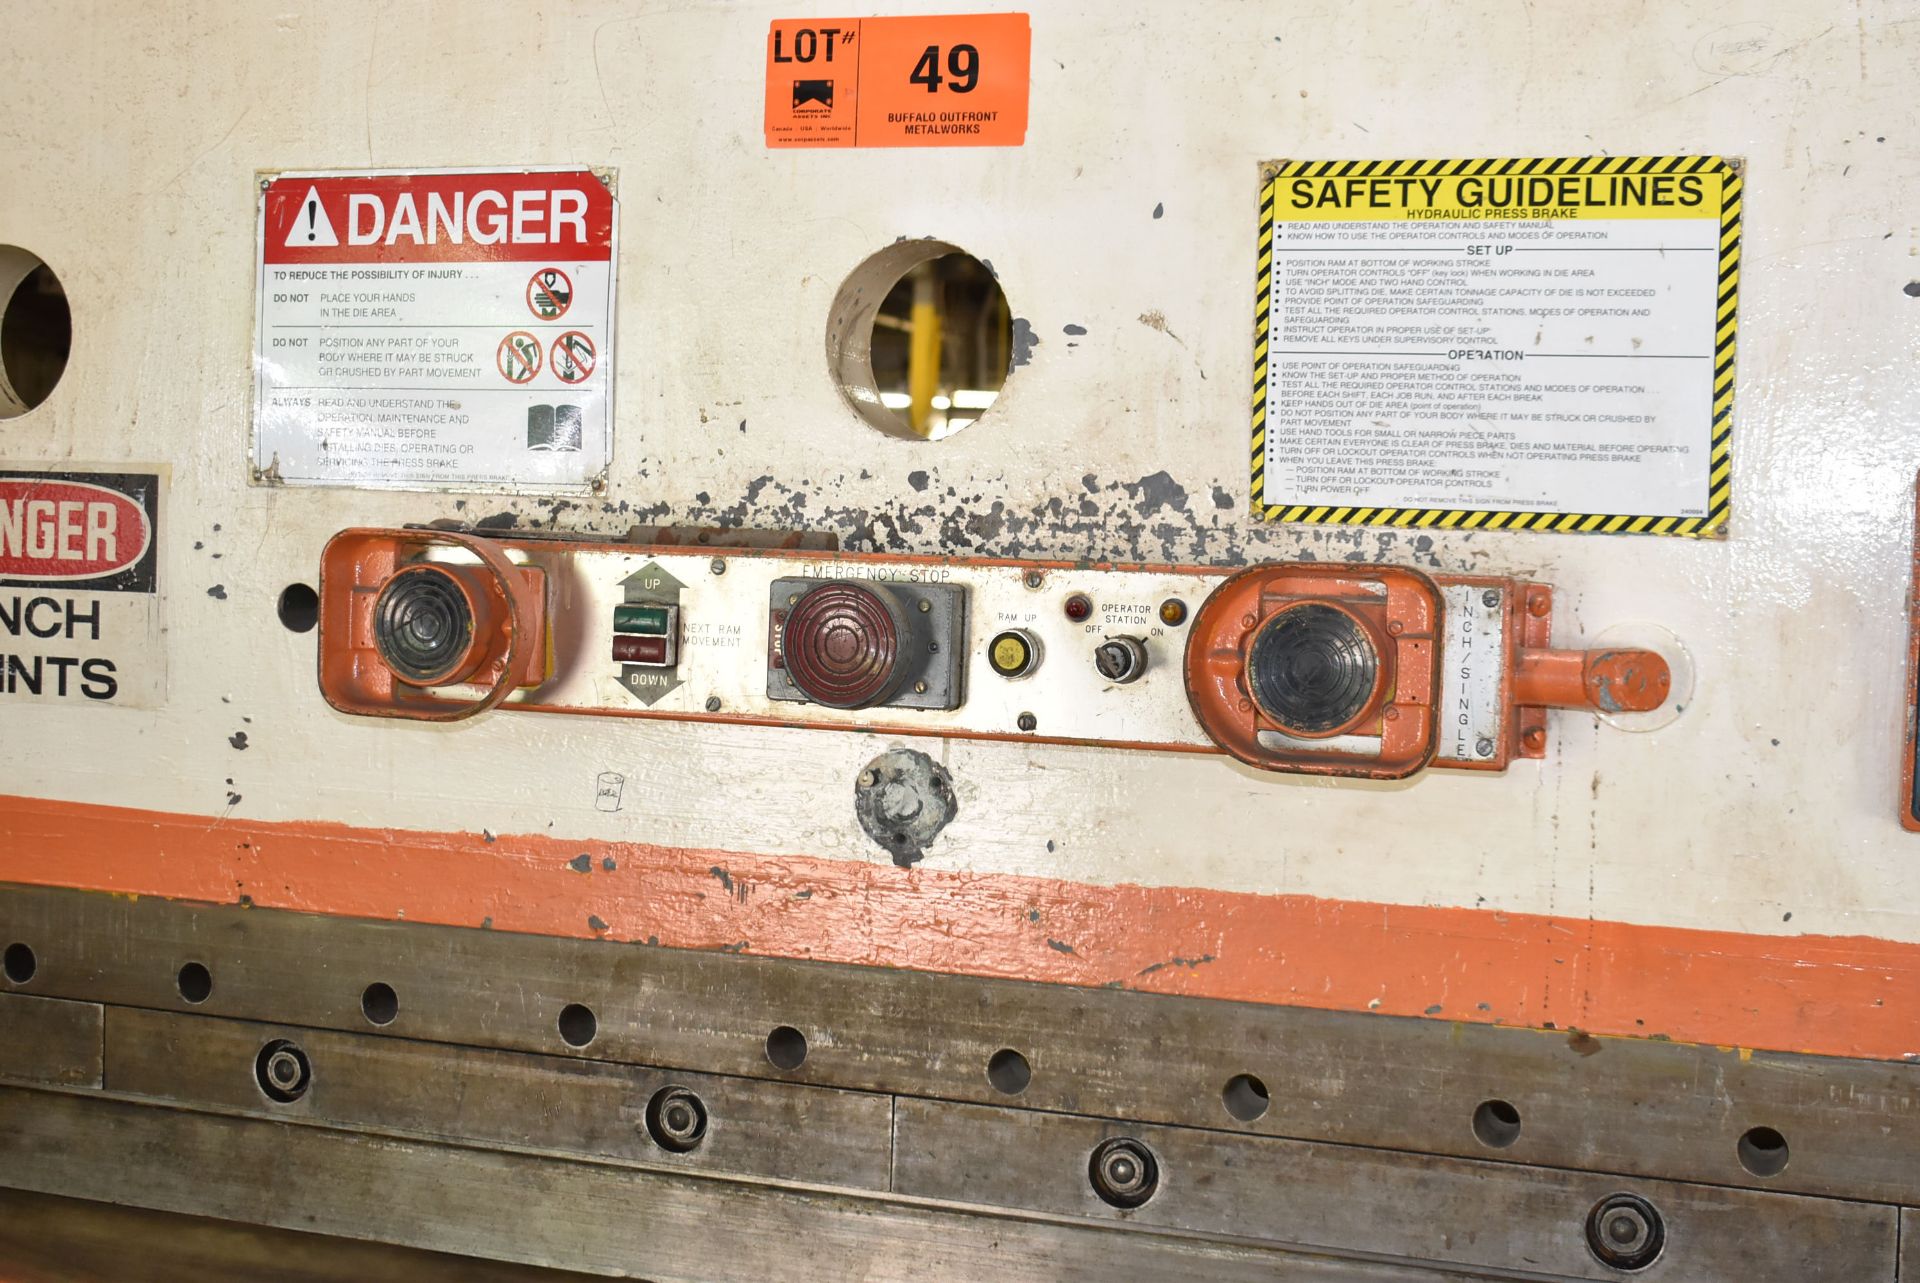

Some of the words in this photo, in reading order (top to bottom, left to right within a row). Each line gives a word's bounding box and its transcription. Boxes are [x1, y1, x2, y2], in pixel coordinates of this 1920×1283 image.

[909, 43, 980, 94] 49
[888, 112, 936, 123] BUFFALO
[940, 111, 998, 122] OUTFRONT
[904, 124, 980, 135] METALWORKS
[1290, 178, 1449, 209] SAFETY
[1455, 175, 1704, 208] GUIDELINES
[347, 189, 588, 246] DANGER
[1407, 209, 1480, 220] HYDRAULIC
[1484, 208, 1528, 219] PRESS
[1532, 208, 1577, 219] BRAKE
[1332, 222, 1389, 230] UNDERSTAND
[1410, 222, 1460, 230] OPERATION
[1482, 222, 1515, 230] SAFETY
[1518, 221, 1554, 229] MANUAL
[1467, 246, 1491, 256] SET
[1495, 246, 1512, 256] UP
[274, 271, 286, 281] TO
[289, 271, 327, 280] REDUCE
[330, 270, 348, 280] THE
[351, 270, 409, 280] POSSIBILITY
[411, 270, 424, 280] OF
[427, 270, 462, 280] INJURY
[274, 294, 287, 303] DO
[289, 294, 308, 303] NOT
[320, 293, 350, 302] PLACE
[353, 293, 380, 302] YOUR
[382, 293, 415, 302] HANDS
[321, 308, 329, 318] IN
[333, 308, 350, 318] THE
[352, 308, 367, 318] DIE
[370, 308, 396, 318] AREA
[1284, 316, 1350, 324] SAFEGUARDING
[272, 338, 286, 347] DO
[288, 338, 308, 347] NOT
[320, 338, 363, 348] POSITION
[366, 338, 385, 348] ANY
[387, 338, 412, 348] PART
[415, 338, 428, 348] OF
[431, 338, 459, 348] YOUR
[319, 353, 345, 362] BODY
[347, 353, 382, 362] WHERE
[385, 353, 392, 362] IT
[395, 353, 416, 362] MAY
[418, 353, 430, 362] BE
[434, 353, 473, 362] STRUCK
[319, 368, 332, 377] OR
[334, 368, 381, 377] CRUSHED
[383, 368, 396, 377] BY
[398, 368, 423, 377] PART
[426, 368, 481, 378] MOVEMENT
[1282, 372, 1307, 380] KNOW
[1360, 372, 1378, 380] AND
[1380, 372, 1415, 381] PROPER
[1418, 373, 1454, 381] METHOD
[1456, 373, 1468, 381] OF
[1470, 373, 1521, 382] OPERATION
[272, 398, 311, 407] ALWAYS
[318, 399, 345, 408] READ
[346, 399, 366, 409] AND
[368, 399, 433, 409] UNDERSTAND
[437, 399, 455, 409] THE
[377, 413, 446, 424] MAINTENANCE
[448, 414, 469, 424] AND
[1304, 419, 1352, 427] MOVEMENT
[397, 428, 436, 439] BEFORE
[1298, 428, 1322, 436] HAND
[1325, 429, 1352, 437] TOOLS
[1354, 429, 1372, 438] FOR
[1374, 430, 1401, 438] SMALL
[1403, 430, 1416, 438] OR
[1418, 430, 1456, 439] NARROW
[1458, 431, 1484, 440] PIECE
[1487, 432, 1516, 440] PARTS
[400, 443, 456, 454] OPERATING
[459, 443, 473, 454] OR
[371, 458, 390, 468] THE
[426, 458, 458, 468] BRAKE
[802, 565, 897, 581] EMERGENCY
[910, 568, 950, 584] STOP
[644, 578, 661, 590] UP
[1101, 603, 1151, 614] OPERATOR
[998, 612, 1018, 622] RAM
[1024, 614, 1037, 622] UP
[1105, 614, 1147, 625] STATION
[683, 622, 710, 634] NEXT
[718, 624, 742, 636] RAM
[1085, 624, 1102, 634] OFF
[1150, 627, 1164, 637] ON
[682, 635, 742, 648] MOVEMENT
[630, 673, 668, 686] DOWN
